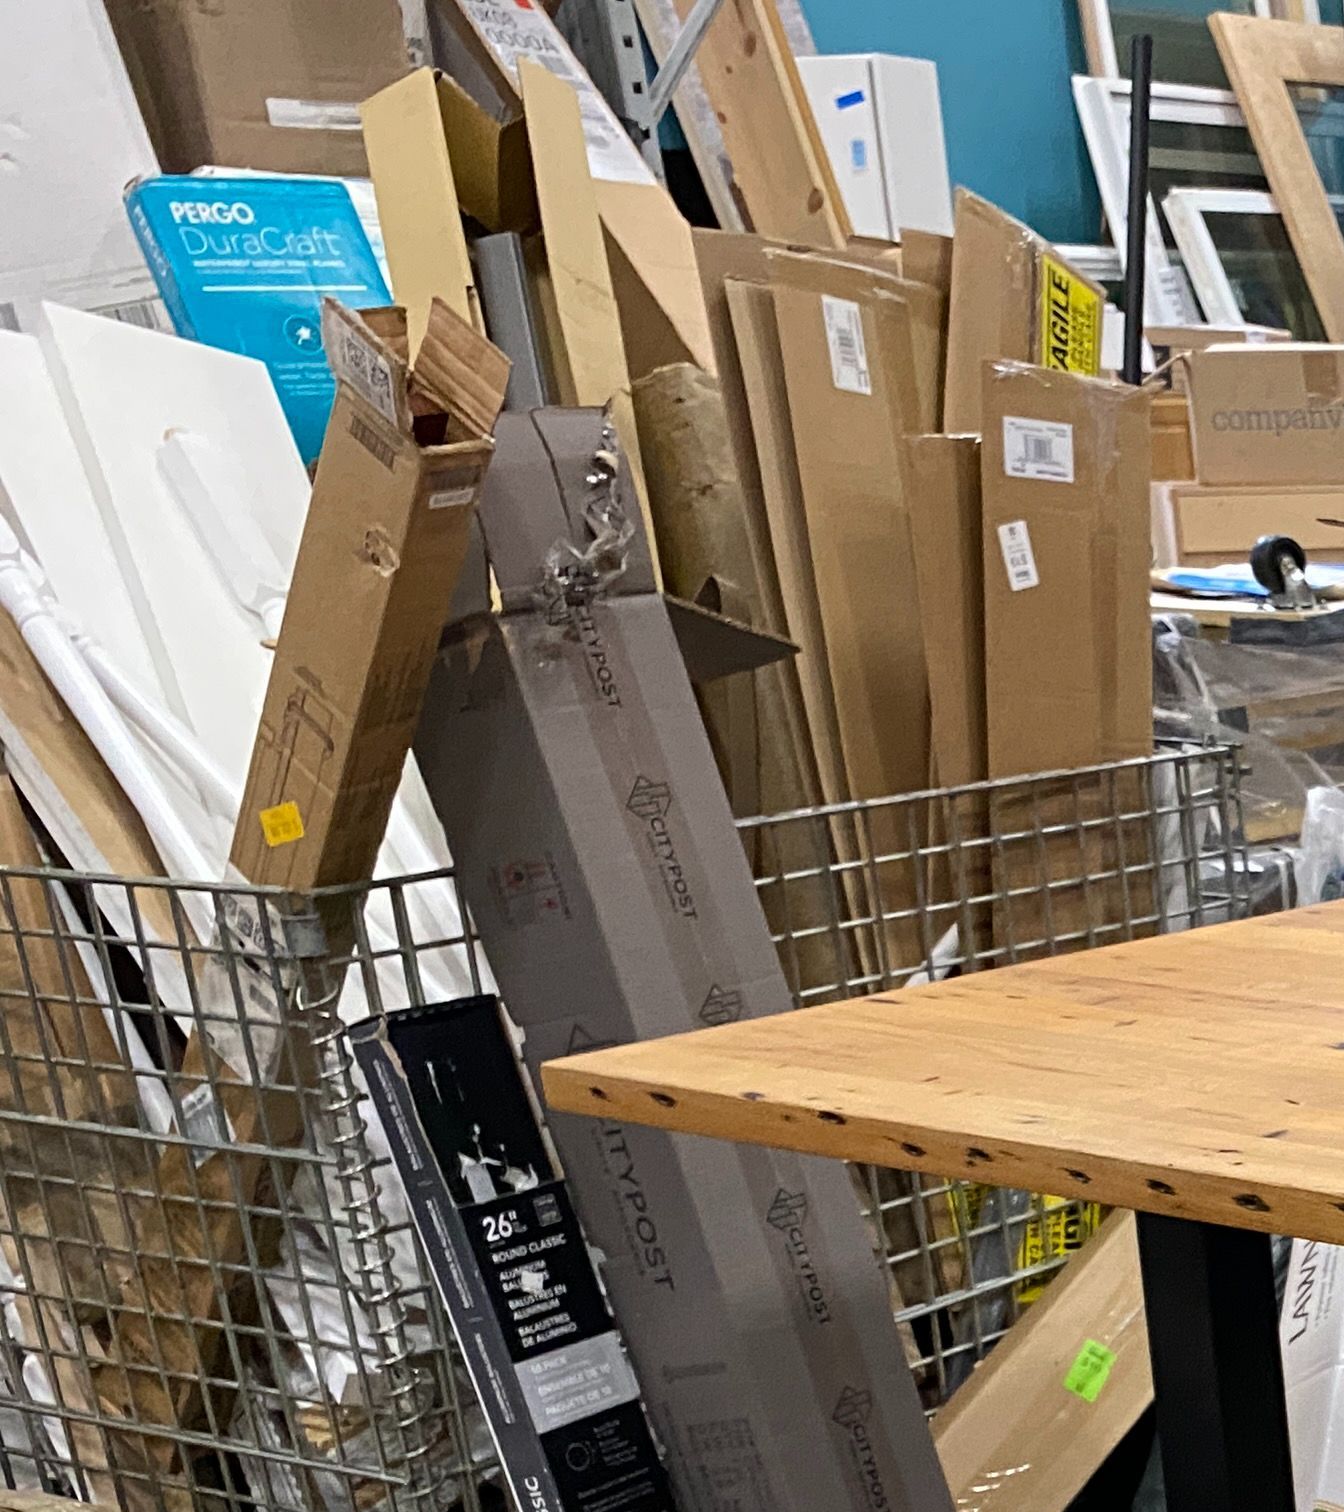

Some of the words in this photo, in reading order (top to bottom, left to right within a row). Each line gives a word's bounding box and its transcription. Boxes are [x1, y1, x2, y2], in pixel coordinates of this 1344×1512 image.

[169, 201, 255, 225] PERGO
[178, 226, 342, 256] DuraCraft
[1051, 268, 1070, 371] AGILE
[650, 816, 699, 922] CITYPOST
[481, 1209, 518, 1242] 26"
[601, 1120, 676, 1292] ITYPOST
[491, 1245, 528, 1265] ROUND
[528, 1233, 567, 1254] CLASSIC
[788, 1227, 831, 1325] CITYPOST
